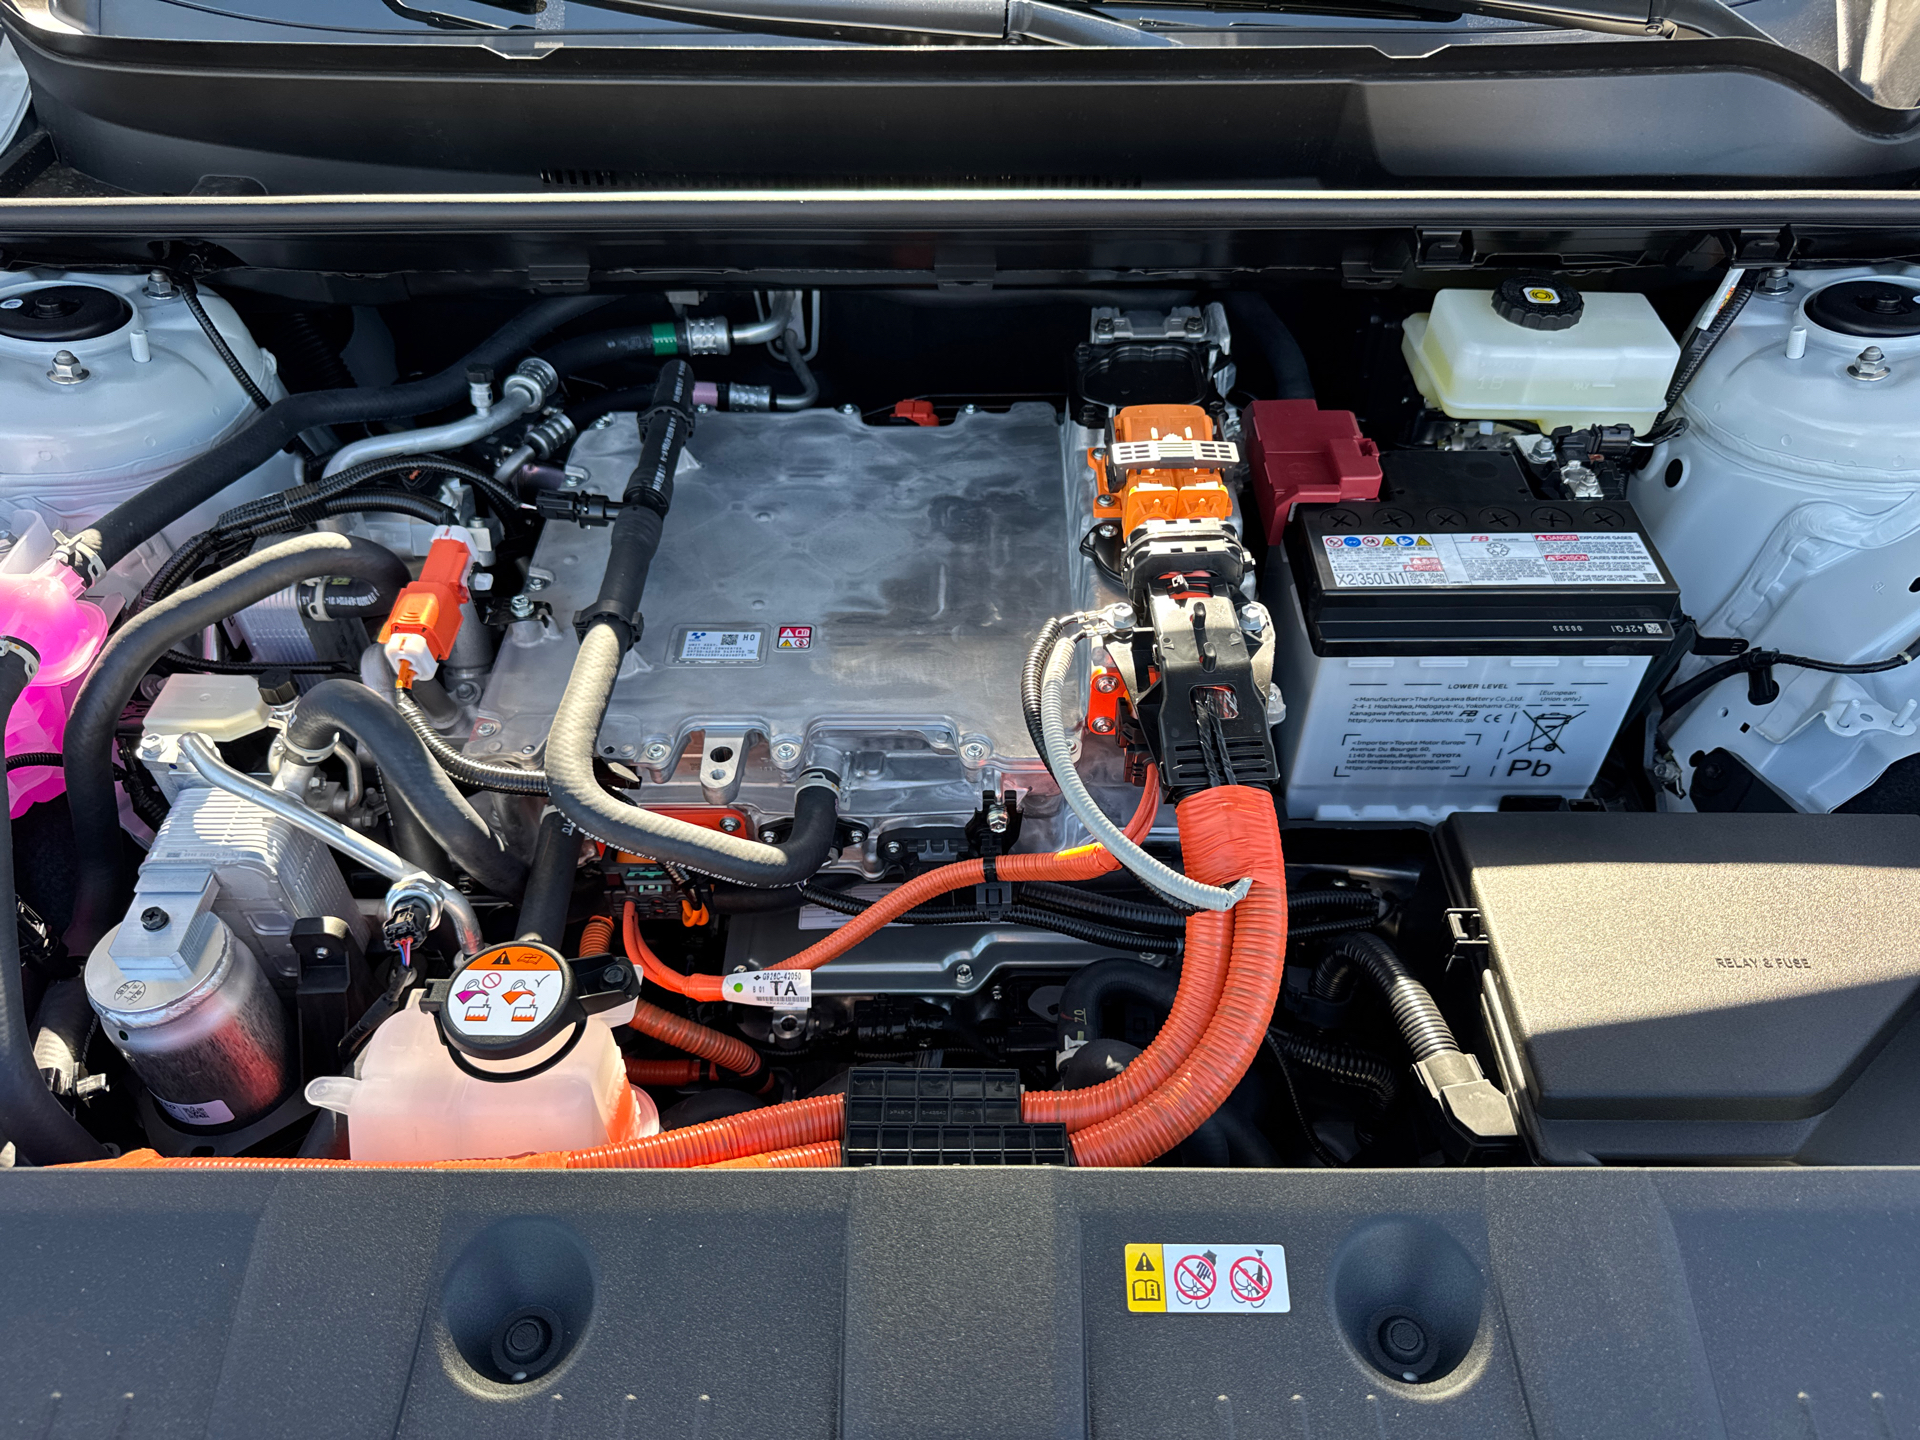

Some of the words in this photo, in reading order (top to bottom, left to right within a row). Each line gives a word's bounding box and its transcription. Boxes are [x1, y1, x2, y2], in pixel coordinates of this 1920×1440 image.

[1336, 573, 1357, 586] X2
[1357, 572, 1406, 585] 350LN1
[1506, 758, 1551, 777] Pb
[1715, 957, 1758, 969] RELAY
[1762, 957, 1774, 968] &
[1775, 957, 1811, 969] FUSE
[770, 981, 797, 995] TA
